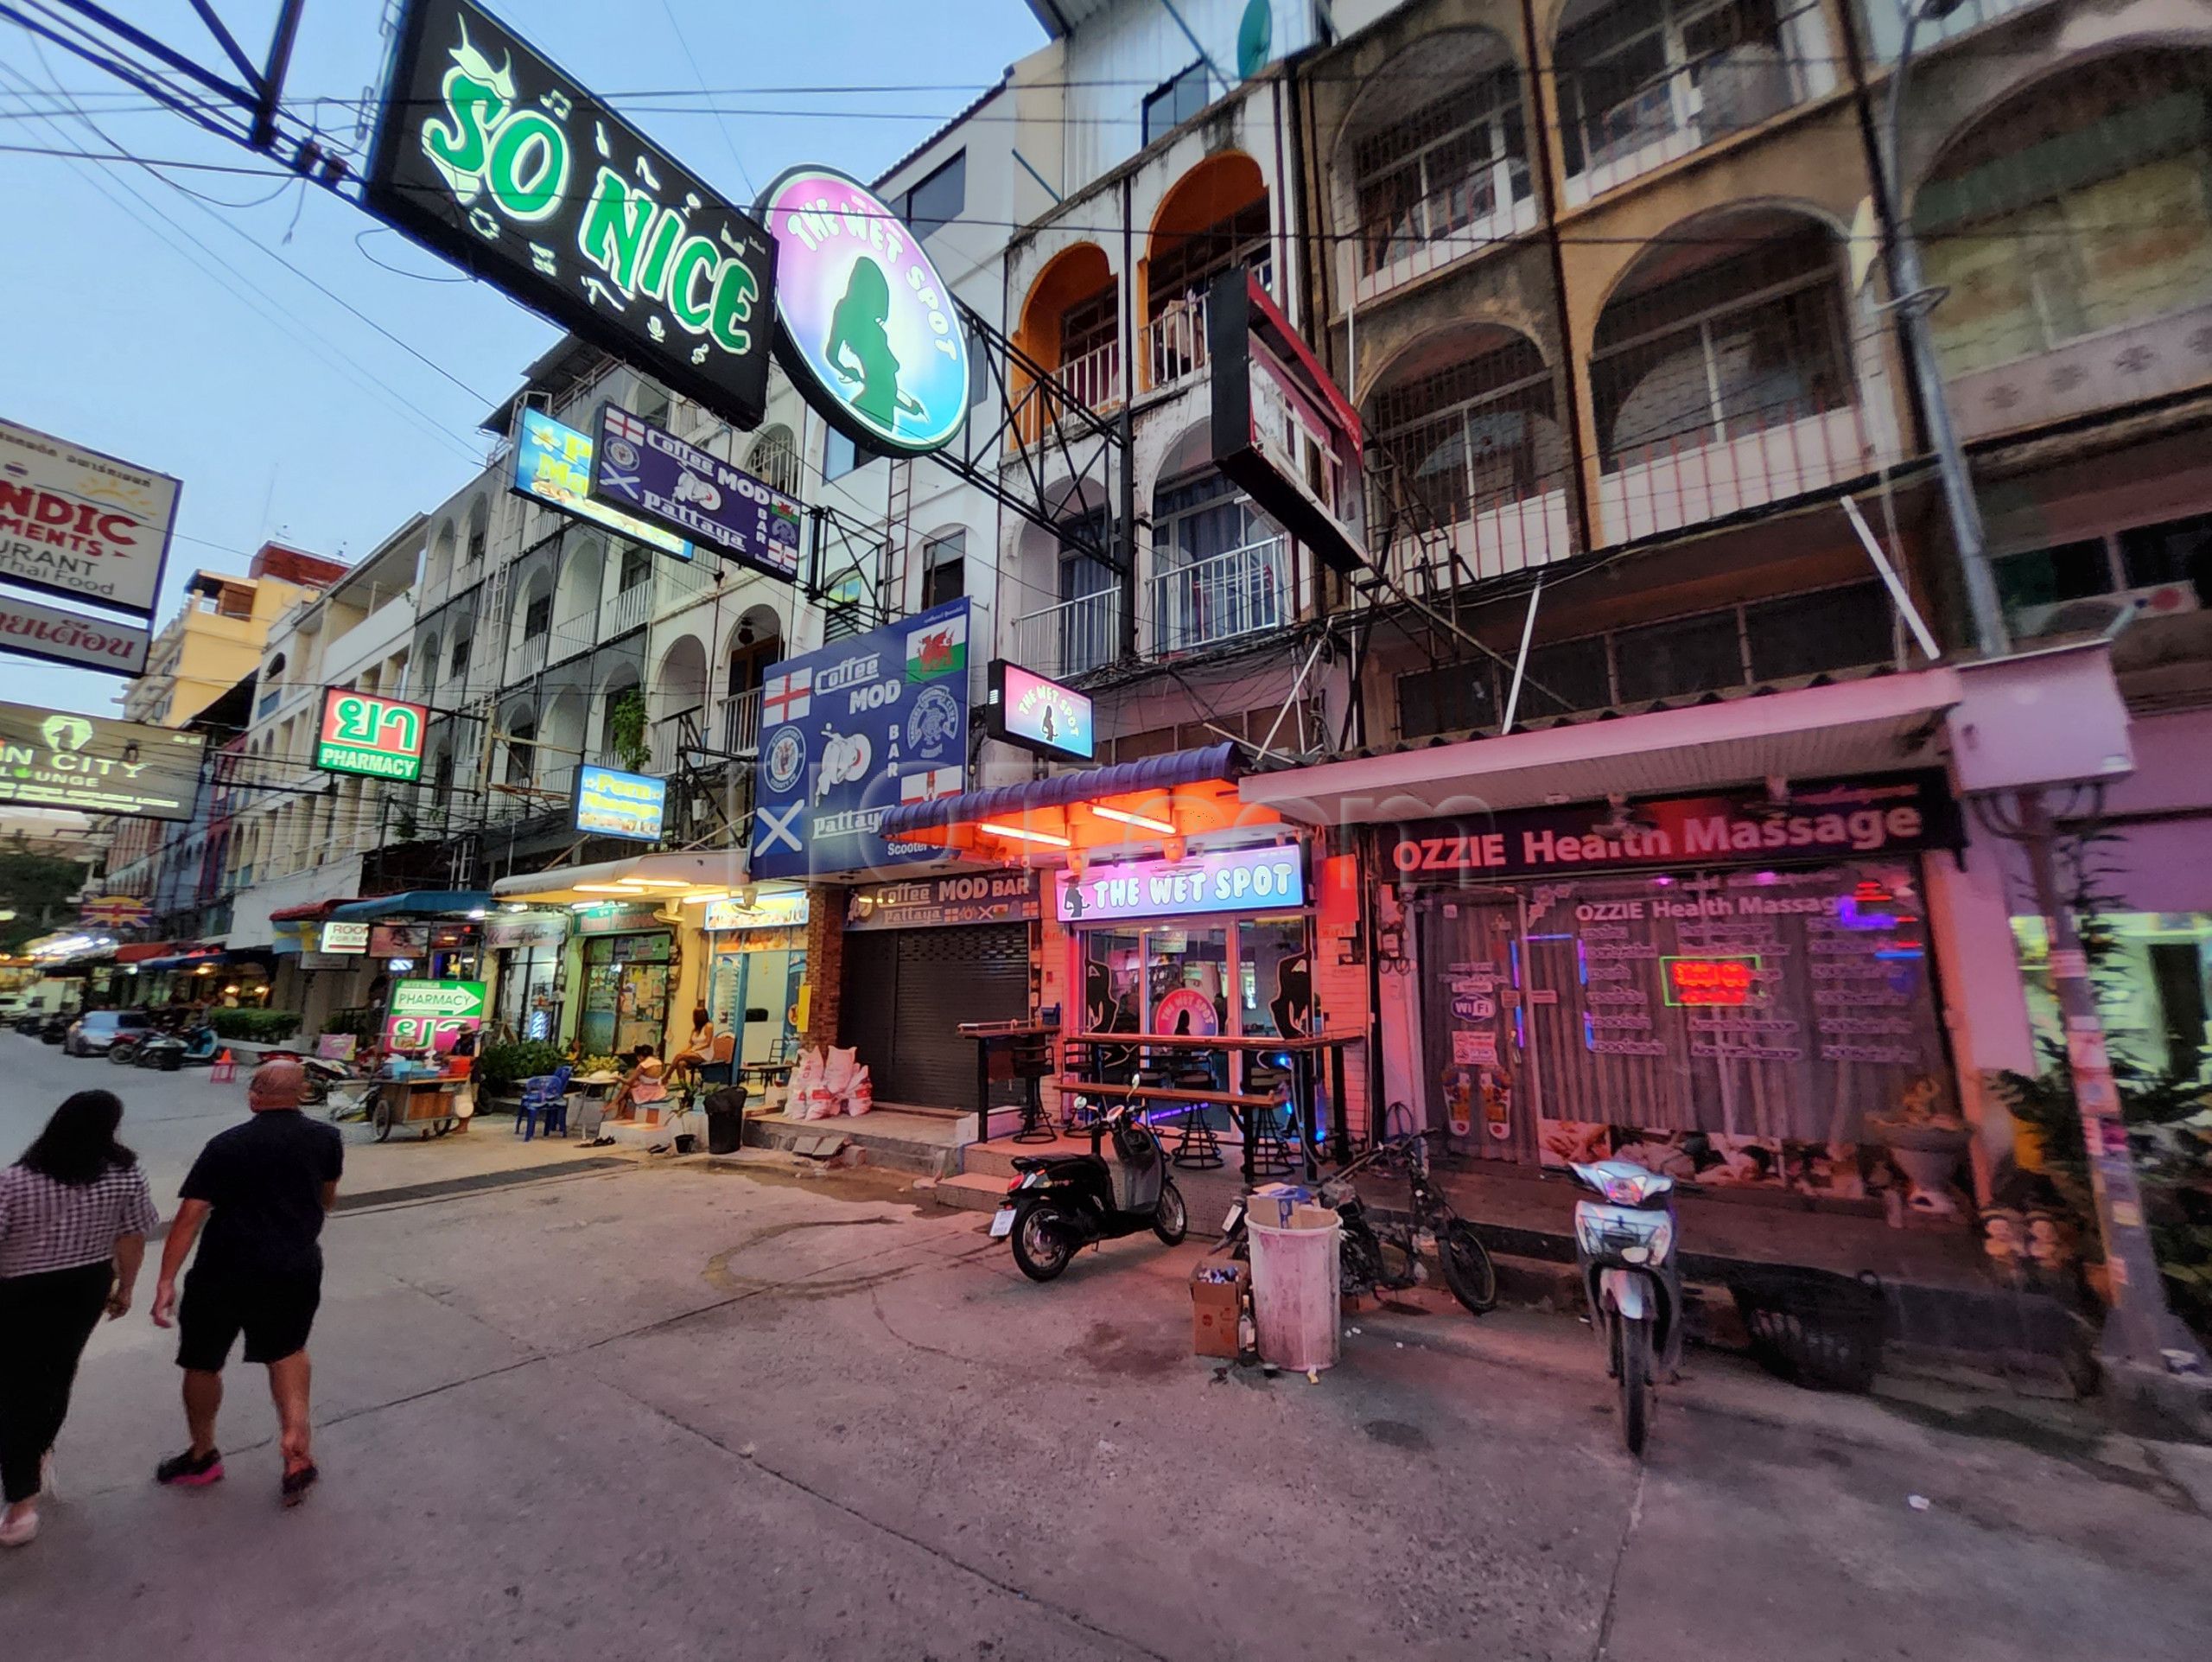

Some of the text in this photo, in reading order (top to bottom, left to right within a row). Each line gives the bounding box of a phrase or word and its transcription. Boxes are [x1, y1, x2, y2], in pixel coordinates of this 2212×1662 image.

[423, 62, 760, 355] SO NICE
[787, 198, 840, 252] THE
[841, 201, 904, 264] WET
[905, 265, 958, 361] SPOT
[646, 429, 771, 506] Coffee MOD
[55, 570, 116, 595] Food
[815, 652, 880, 697] Coffee
[849, 679, 901, 716] MOD
[1018, 689, 1037, 716] THE
[1037, 685, 1059, 704] WET
[1059, 698, 1080, 737] SPOT
[334, 696, 420, 754] ยา
[51, 754, 154, 778] CITY
[321, 748, 416, 779] PHARMACY
[888, 724, 899, 778] BAR
[1393, 833, 1507, 872] OZZIE
[1683, 806, 1923, 854] Massage
[877, 877, 1029, 908] Coffee MOD BAR
[1092, 863, 1293, 908] THE WET SPOT
[1575, 895, 1847, 921] OZZIE Health Massag
[398, 991, 472, 1008] PHARMACY
